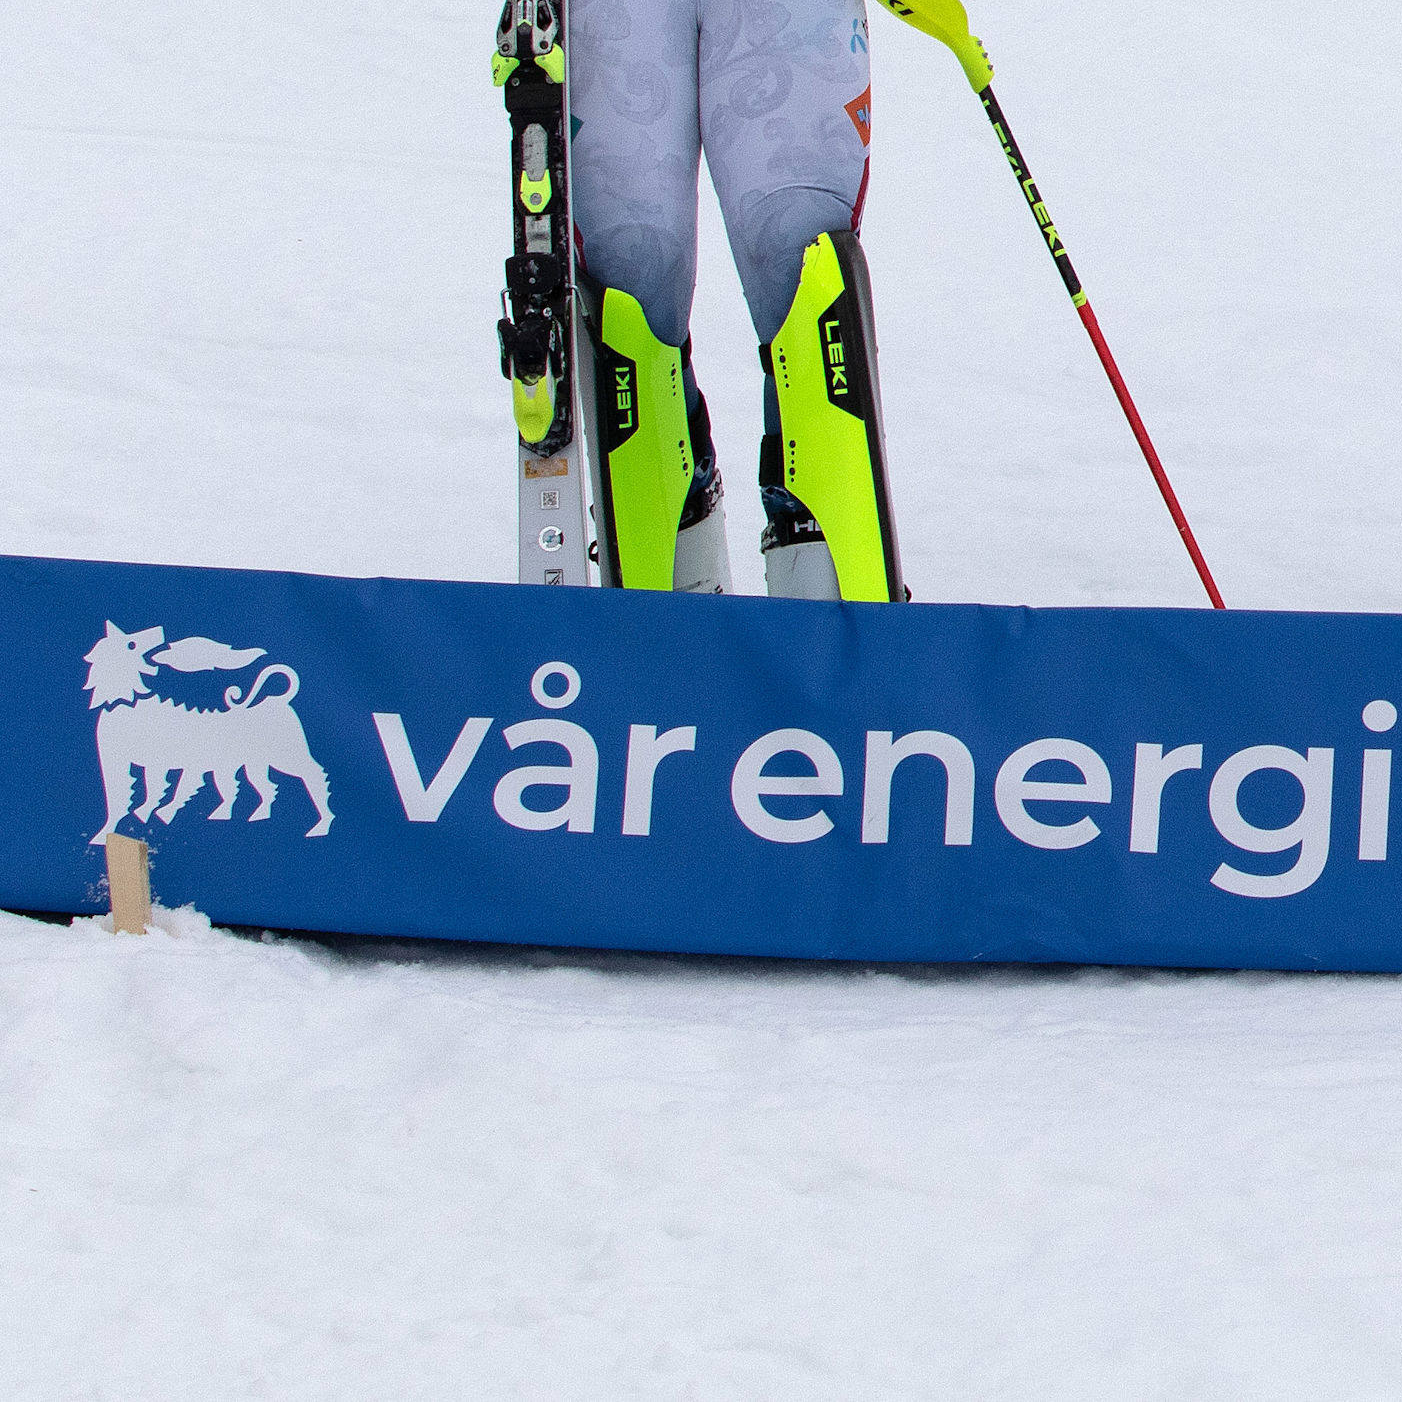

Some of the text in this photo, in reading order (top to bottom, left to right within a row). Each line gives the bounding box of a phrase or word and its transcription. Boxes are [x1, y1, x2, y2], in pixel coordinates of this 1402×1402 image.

[1023, 178, 1067, 257] LEKI
[825, 320, 848, 396] LEKI
[615, 366, 633, 430] LEKI
[372, 660, 1399, 899] vår energi
